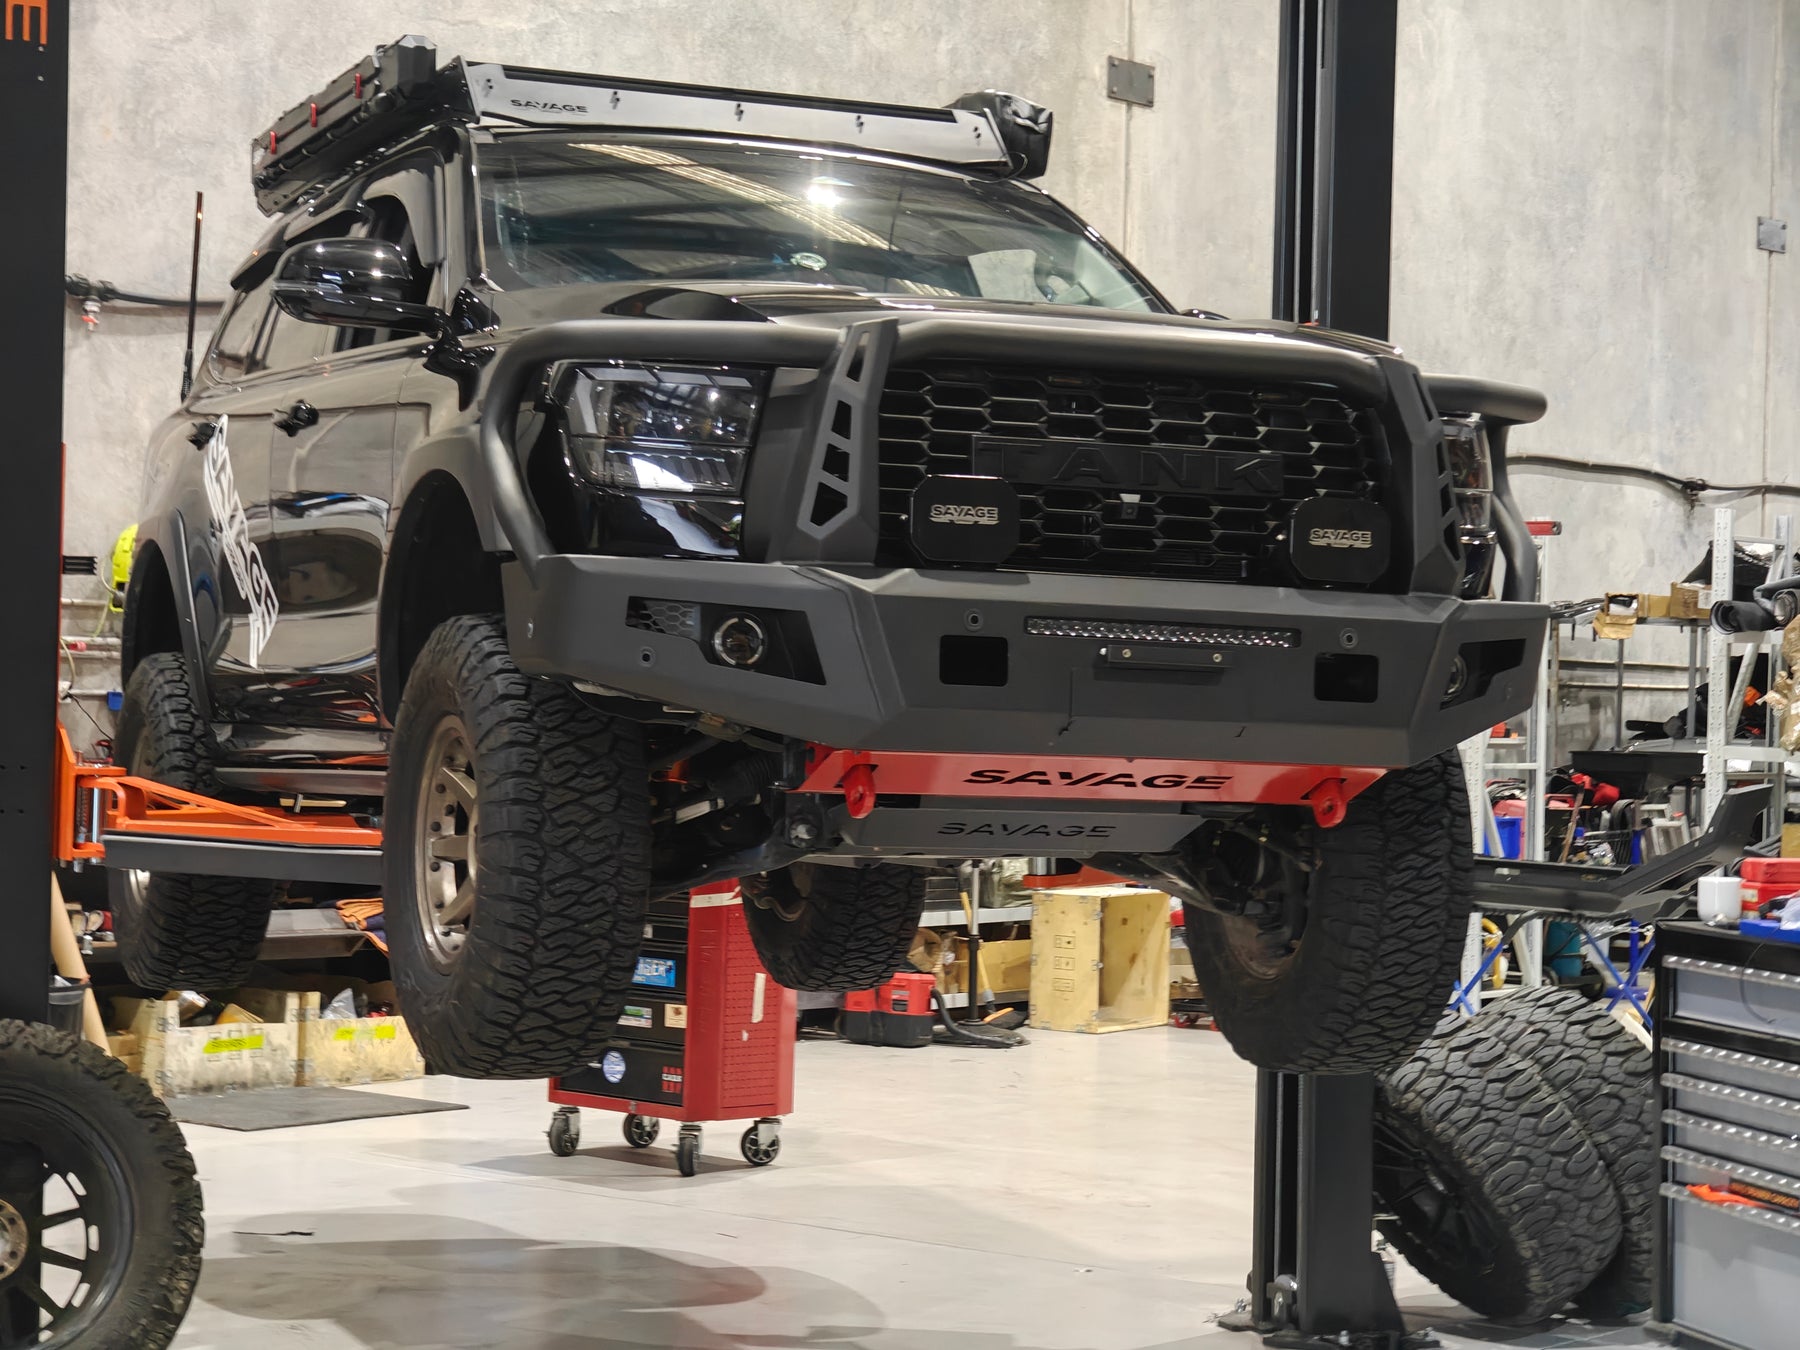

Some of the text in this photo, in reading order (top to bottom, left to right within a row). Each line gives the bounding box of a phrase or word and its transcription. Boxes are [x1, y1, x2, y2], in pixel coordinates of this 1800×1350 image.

[510, 99, 588, 114] SAVAGE
[978, 441, 1281, 494] TANK
[931, 505, 998, 520] SAVAGE
[1310, 529, 1371, 544] SAVAGE
[963, 769, 1233, 790] SAVAGE
[937, 822, 1116, 838] SAVAGE
